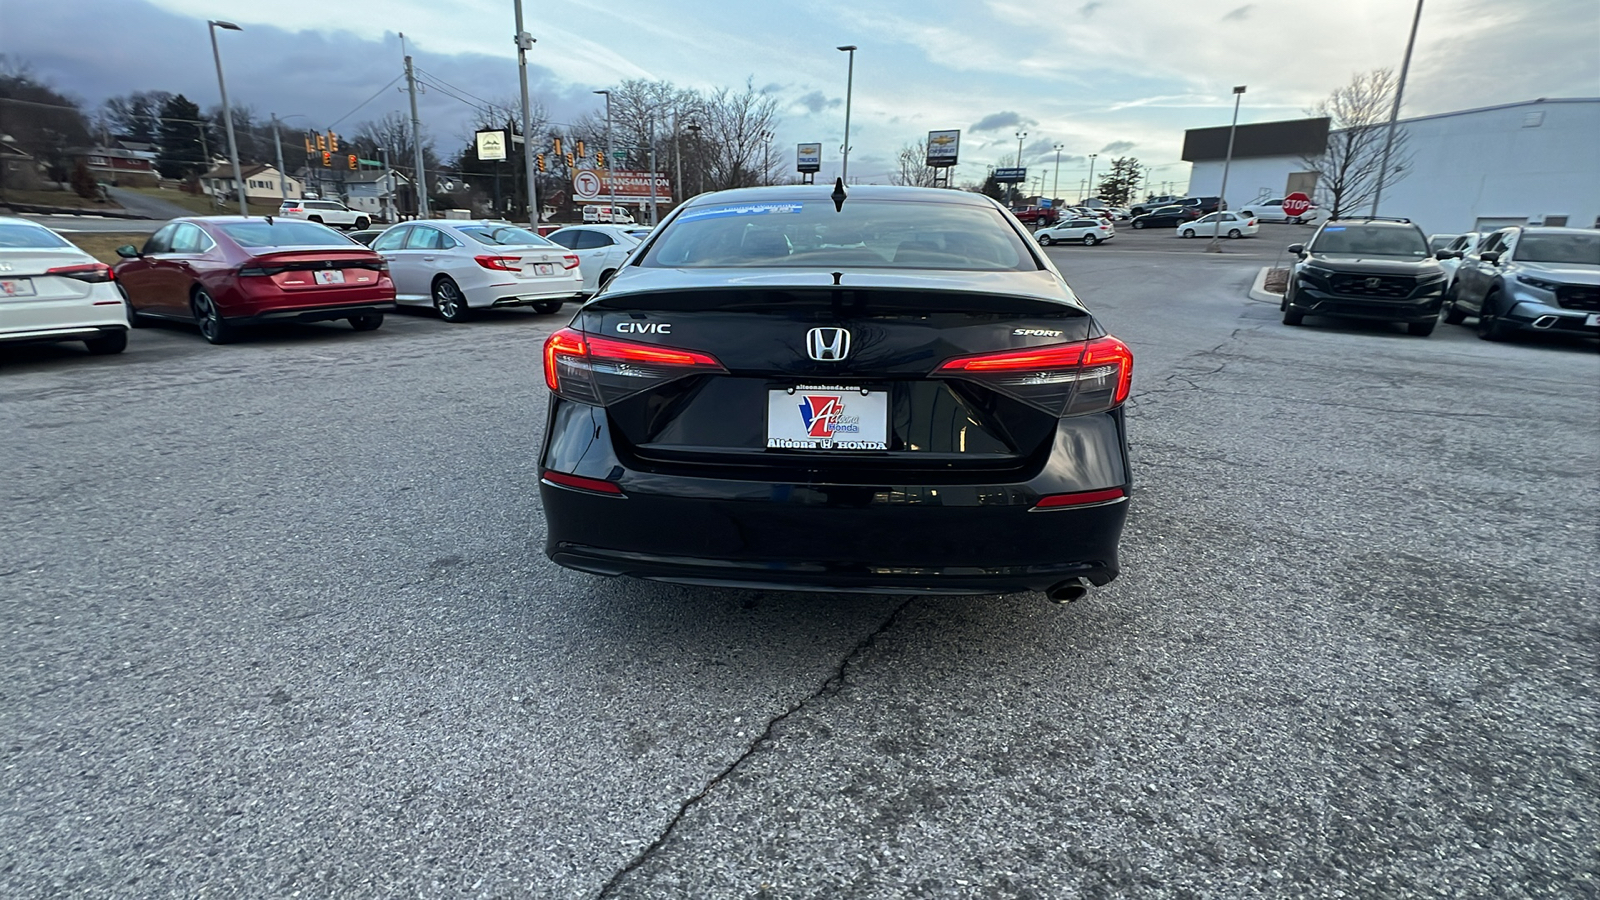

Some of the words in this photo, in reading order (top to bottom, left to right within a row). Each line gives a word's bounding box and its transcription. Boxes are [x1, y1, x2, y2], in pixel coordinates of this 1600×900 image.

[602, 177, 670, 187] TRANS4MATON
[1284, 199, 1309, 210] STOP
[616, 322, 671, 334] CIVIC
[1012, 328, 1063, 337] SPORT
[828, 423, 859, 431] Honda
[767, 438, 816, 448] Altoona
[837, 441, 887, 449] HONDA
